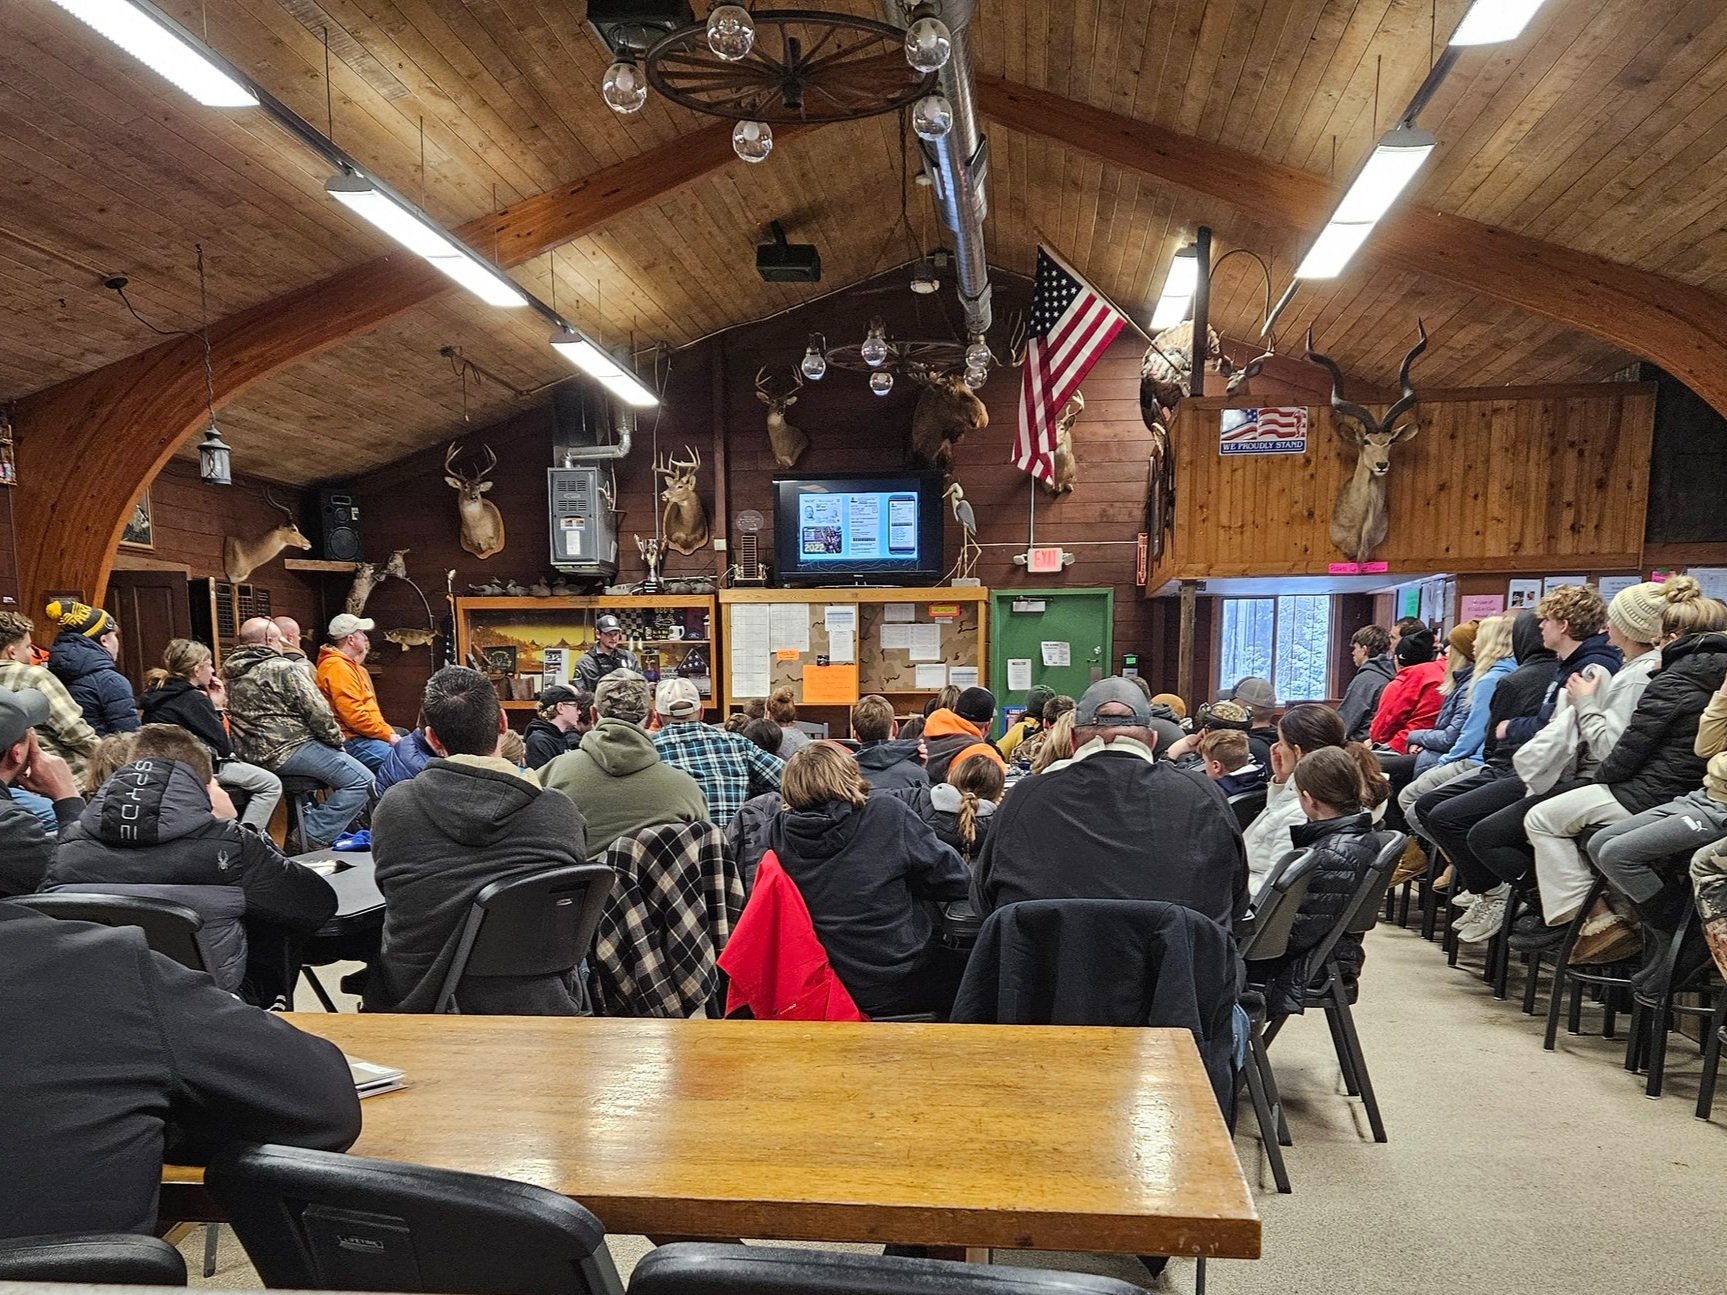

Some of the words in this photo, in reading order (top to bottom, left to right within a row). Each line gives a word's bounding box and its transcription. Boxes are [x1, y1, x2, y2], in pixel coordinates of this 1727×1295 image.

[1223, 443, 1237, 451] WE
[1238, 442, 1274, 450] PROUDLY
[1276, 440, 1303, 449] STAND
[804, 543, 825, 553] 2022
[1034, 550, 1057, 568] EXIT
